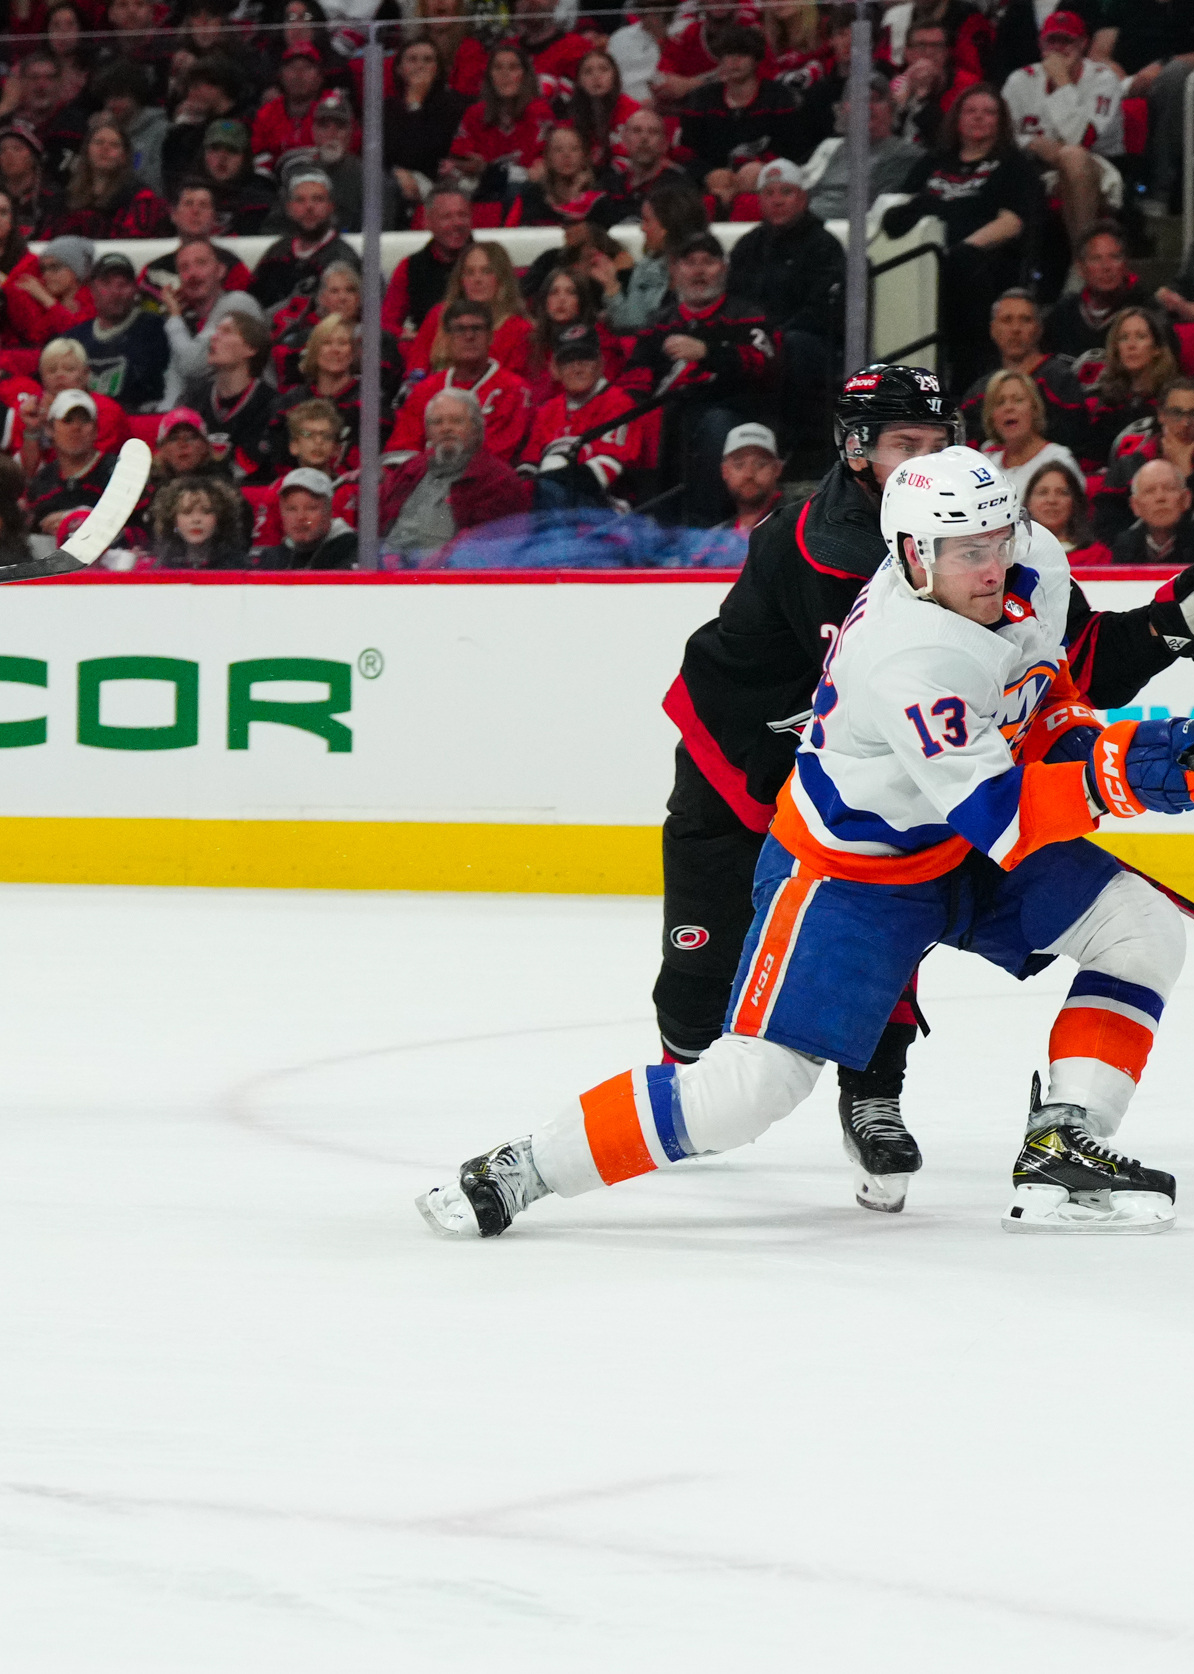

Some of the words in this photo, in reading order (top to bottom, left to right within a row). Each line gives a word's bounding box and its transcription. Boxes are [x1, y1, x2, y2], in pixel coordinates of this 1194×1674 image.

[907, 473, 934, 490] UBS
[970, 467, 992, 483] 13
[977, 495, 1008, 510] CCM
[904, 696, 969, 759] 13
[1102, 740, 1140, 816] CCM
[749, 952, 776, 1008] CCM
